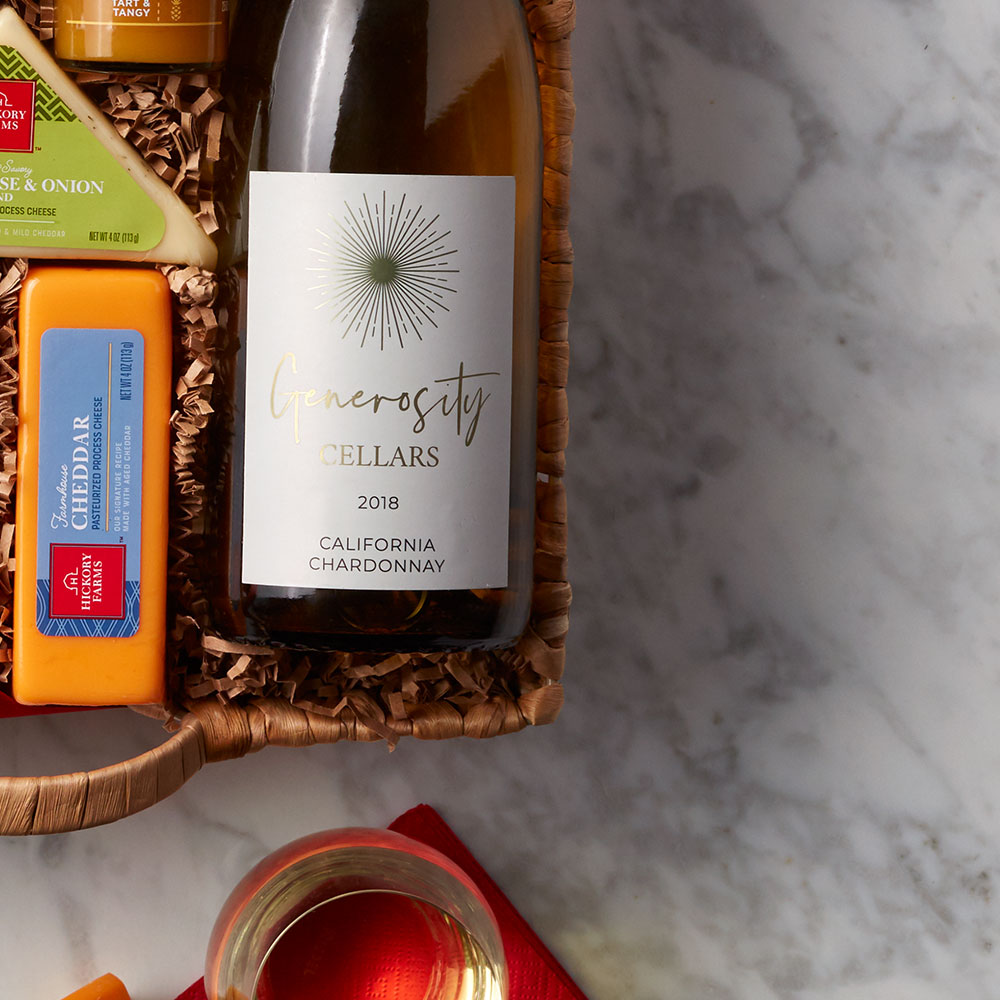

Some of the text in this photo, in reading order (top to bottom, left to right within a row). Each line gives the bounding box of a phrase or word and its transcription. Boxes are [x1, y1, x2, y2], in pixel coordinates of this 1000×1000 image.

[143, 0, 150, 7] &
[113, 8, 150, 17] TANGY
[24, 179, 37, 191] &
[42, 179, 104, 195] ONION
[27, 207, 56, 217] CHEESE
[89, 231, 99, 242] NET
[100, 231, 107, 242] WT
[113, 232, 120, 242] OZ
[121, 349, 133, 362] (113
[120, 363, 132, 372] OZ
[120, 378, 131, 389] WT
[120, 390, 131, 400] NET
[270, 352, 501, 447] Generosity
[92, 397, 103, 530] PASTEURIZED PROCESS CHEESE
[320, 444, 439, 467] CELLARS
[71, 415, 90, 531] CHEDDAR
[51, 464, 68, 529] Farmhouse
[114, 472, 122, 514] SIGNATURE
[357, 496, 399, 510] 2018
[320, 536, 436, 552] CALIFORNIA
[309, 557, 445, 573] CHARDONNAY
[81, 553, 92, 611] HICKORY
[92, 560, 103, 602] FARMS
